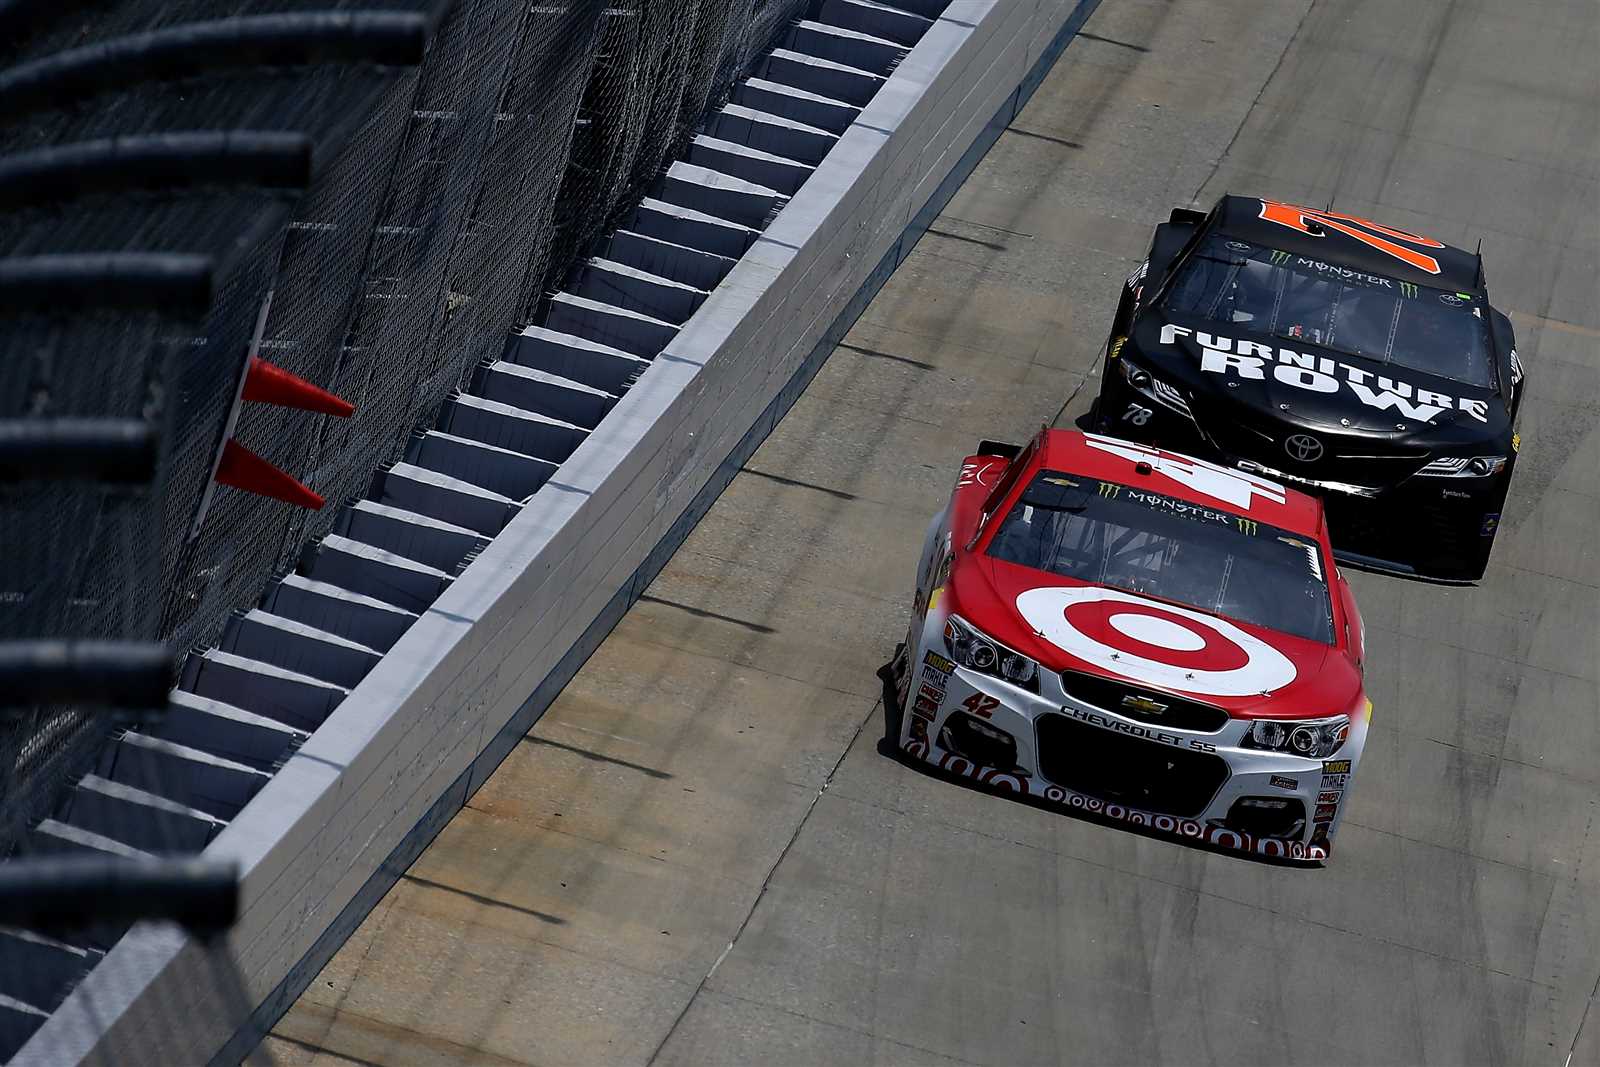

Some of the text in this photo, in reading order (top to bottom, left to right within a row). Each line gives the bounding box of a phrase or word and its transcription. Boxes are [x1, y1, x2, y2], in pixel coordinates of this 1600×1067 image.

[1297, 257, 1393, 289] MONSTER
[1159, 323, 1489, 423] FURNITURE
[1200, 347, 1447, 423] ROW
[1121, 402, 1153, 426] 78
[1128, 490, 1229, 525] MONSTER
[926, 653, 955, 673] MOOG
[962, 691, 1001, 719] 42
[1060, 705, 1217, 753] CHEVROLET SS
